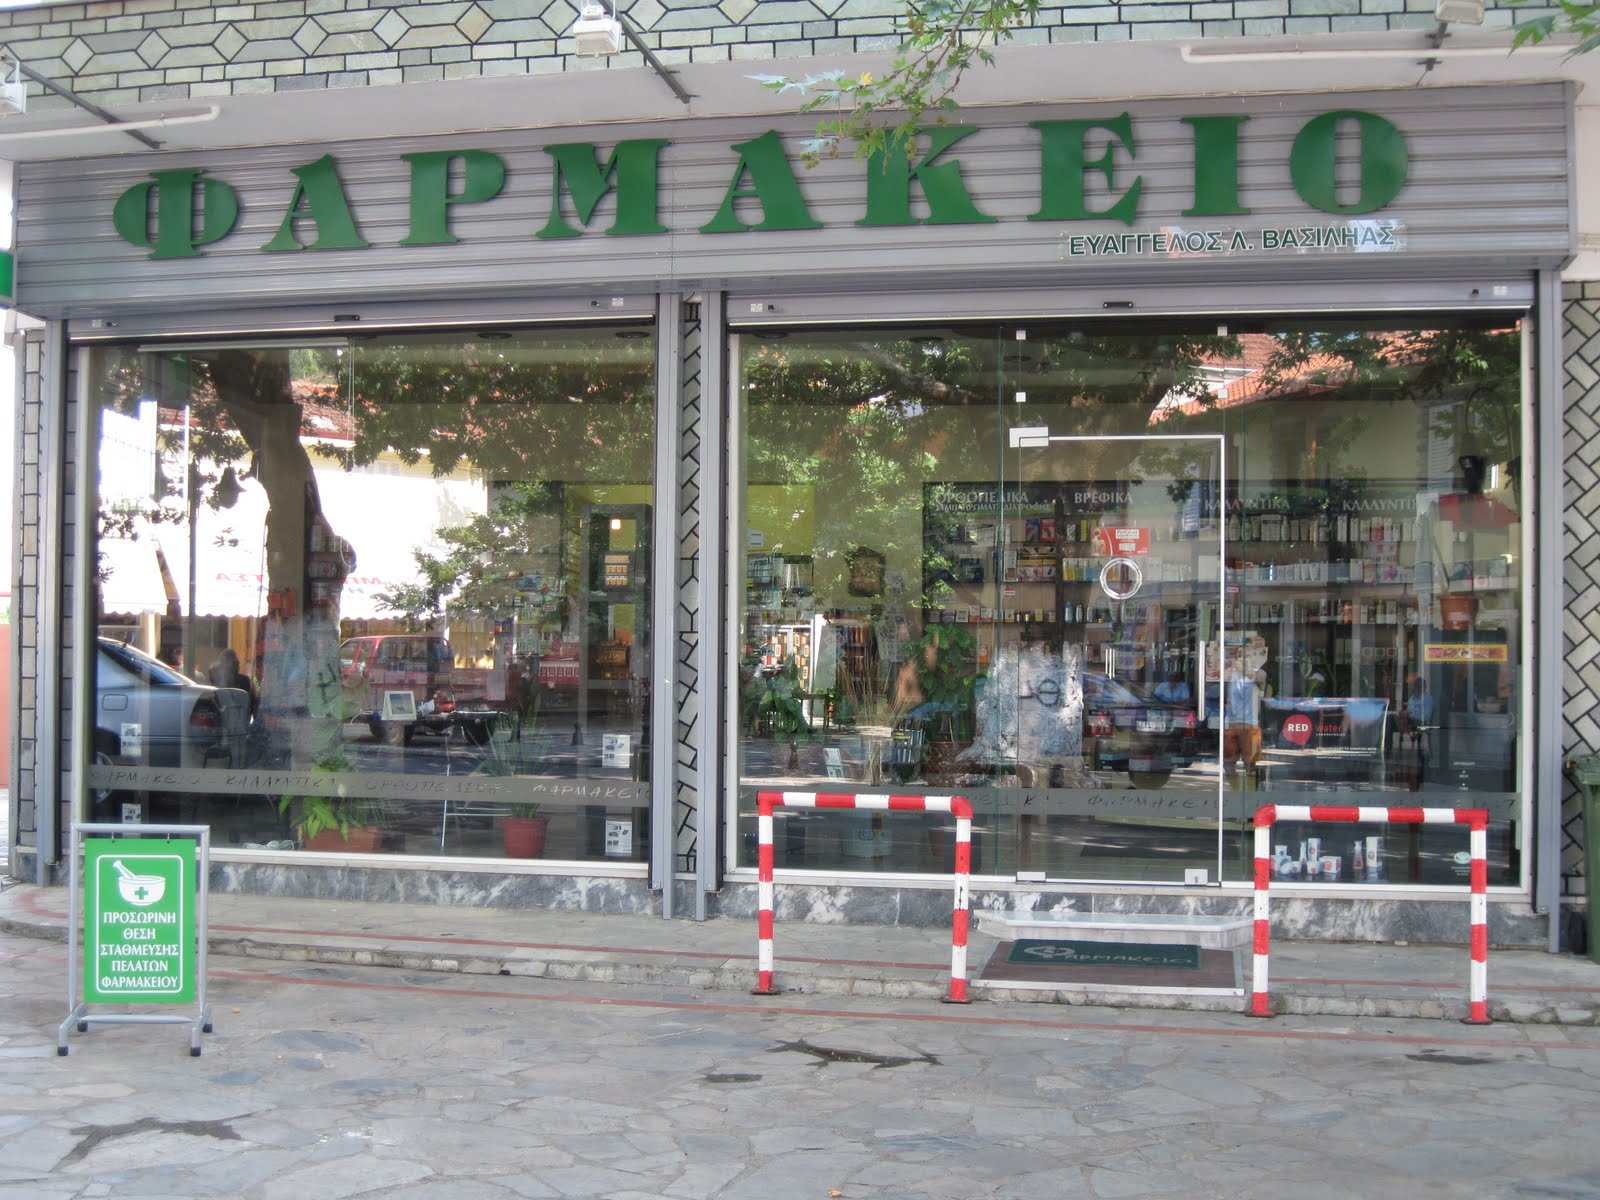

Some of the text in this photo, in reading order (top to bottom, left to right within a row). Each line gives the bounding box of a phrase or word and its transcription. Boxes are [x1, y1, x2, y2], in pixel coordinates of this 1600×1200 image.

[113, 110, 1408, 260] ΦΑΡΜΑΚΕΙΟ
[1069, 225, 1395, 256] ΕΥΑΓΓΕΛΟΣ Λ. ΒΑΣΙΛΗΑΣ
[1074, 492, 1134, 504] ΒΡΕΦΙΚΑ
[1343, 499, 1416, 511] ΚΑΛΛΥΝΤΙ
[1288, 723, 1309, 732] RED
[104, 911, 176, 923] ΠΡΟΣΩΡΙΝΗ
[123, 928, 156, 940] ΘΕΣΗ
[100, 944, 179, 956] ΣΤΑΘΜΕΥΣΗΣ
[111, 960, 168, 972] ΠΕΛΑΤΩΝ
[101, 976, 178, 988] ΦΑΡΜΑΚΕΙΟΥ
